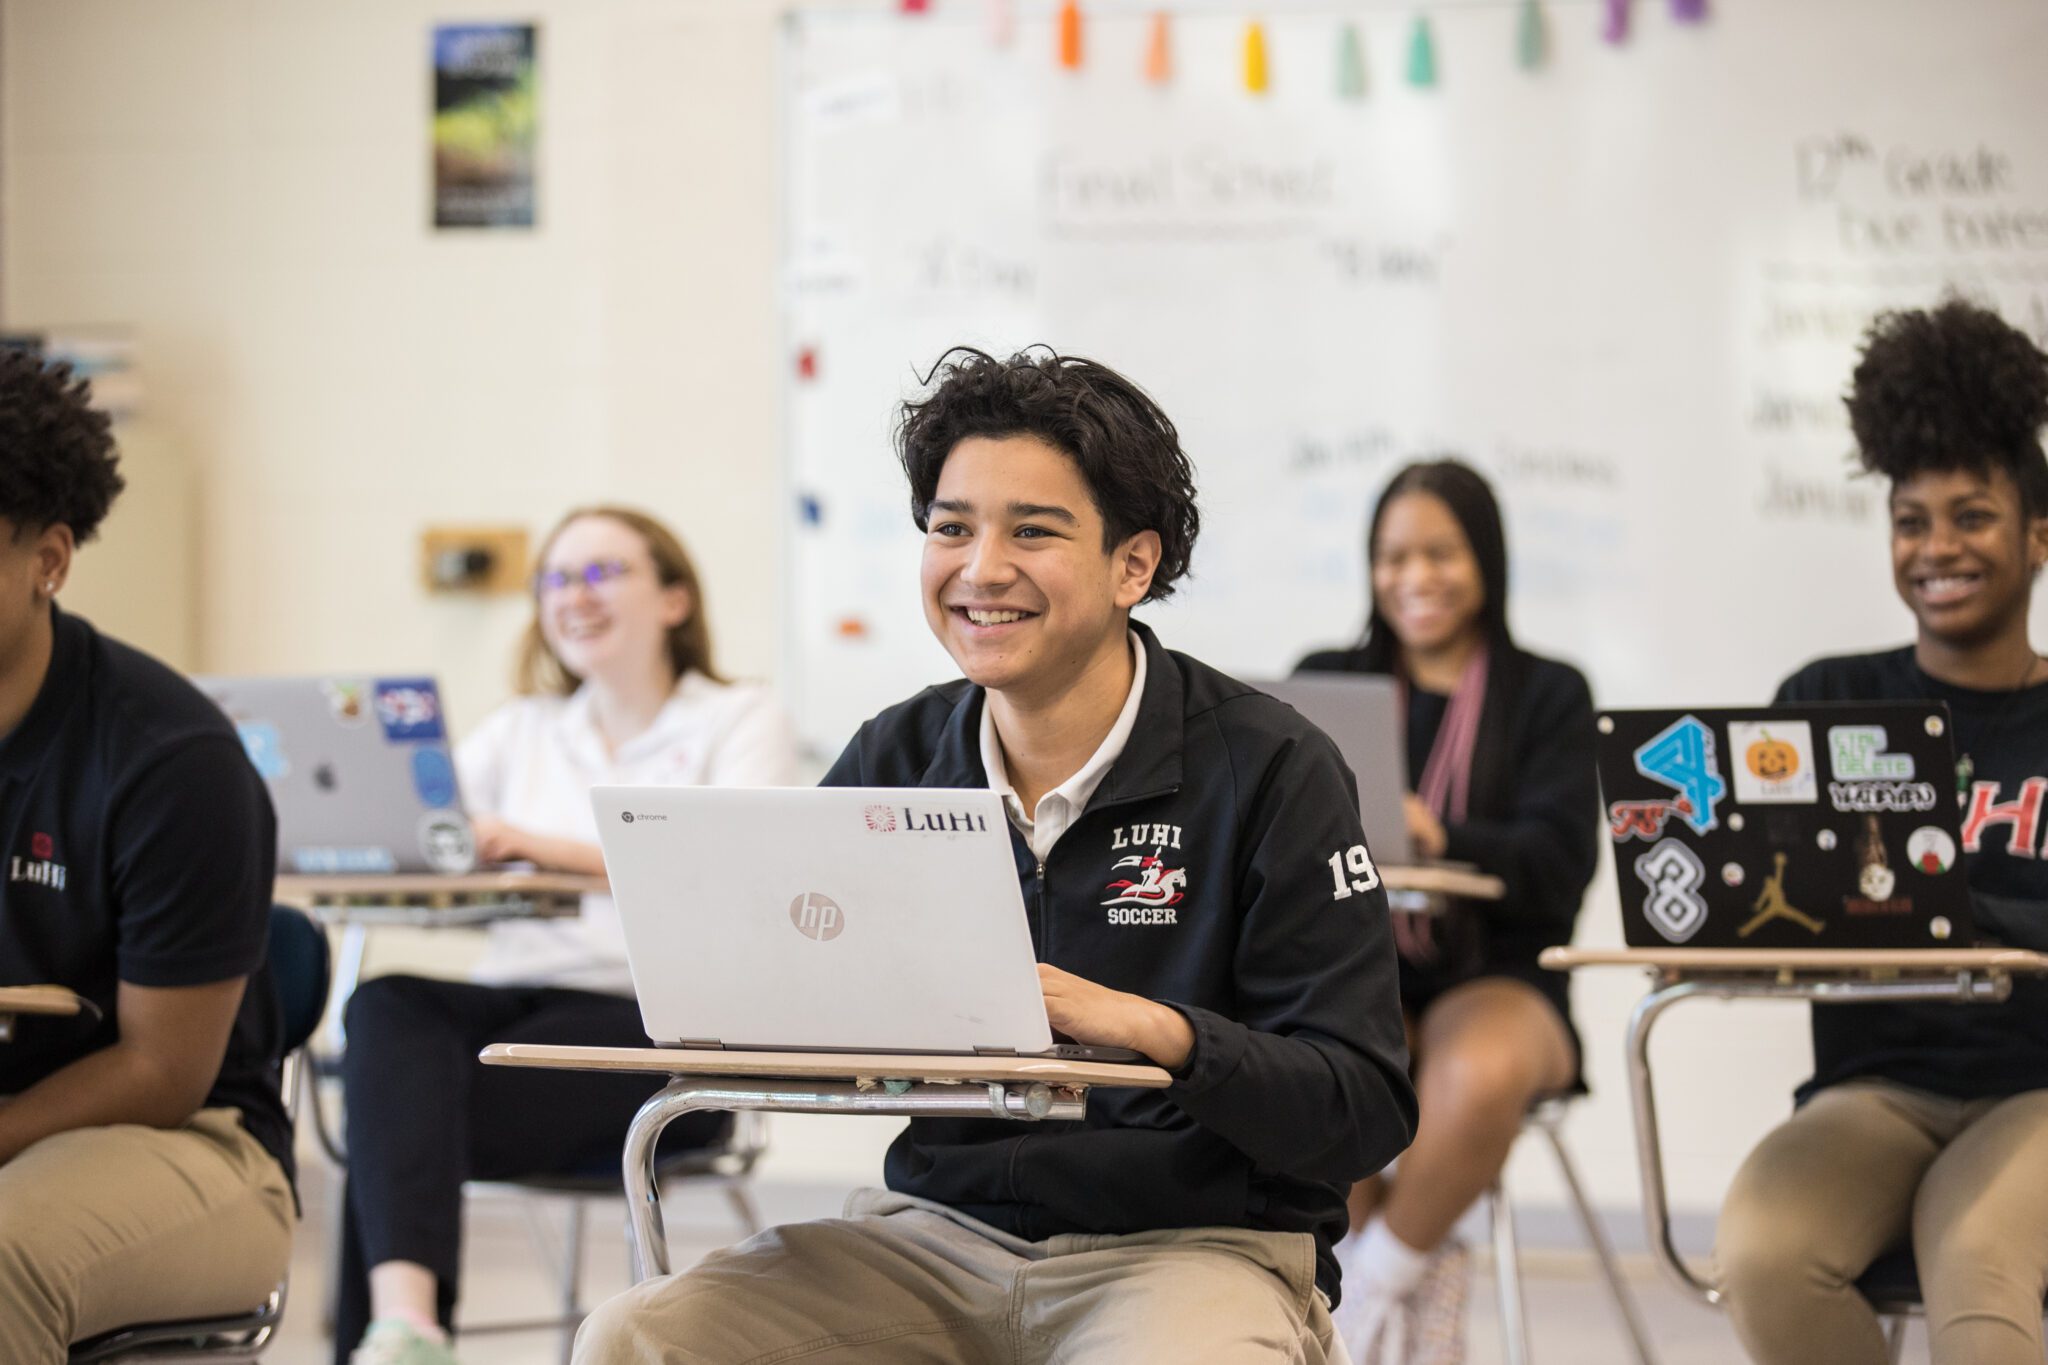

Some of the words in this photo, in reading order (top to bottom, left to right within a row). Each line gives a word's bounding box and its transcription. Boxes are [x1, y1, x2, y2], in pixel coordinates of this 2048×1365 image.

[1838, 759, 1908, 775] DELETE
[637, 813, 667, 821] chrome
[1961, 776, 2047, 860] H
[1112, 823, 1182, 850] LUHI
[1328, 844, 1380, 901] 19
[795, 892, 841, 941] hp
[1108, 908, 1178, 925] SOCCER
